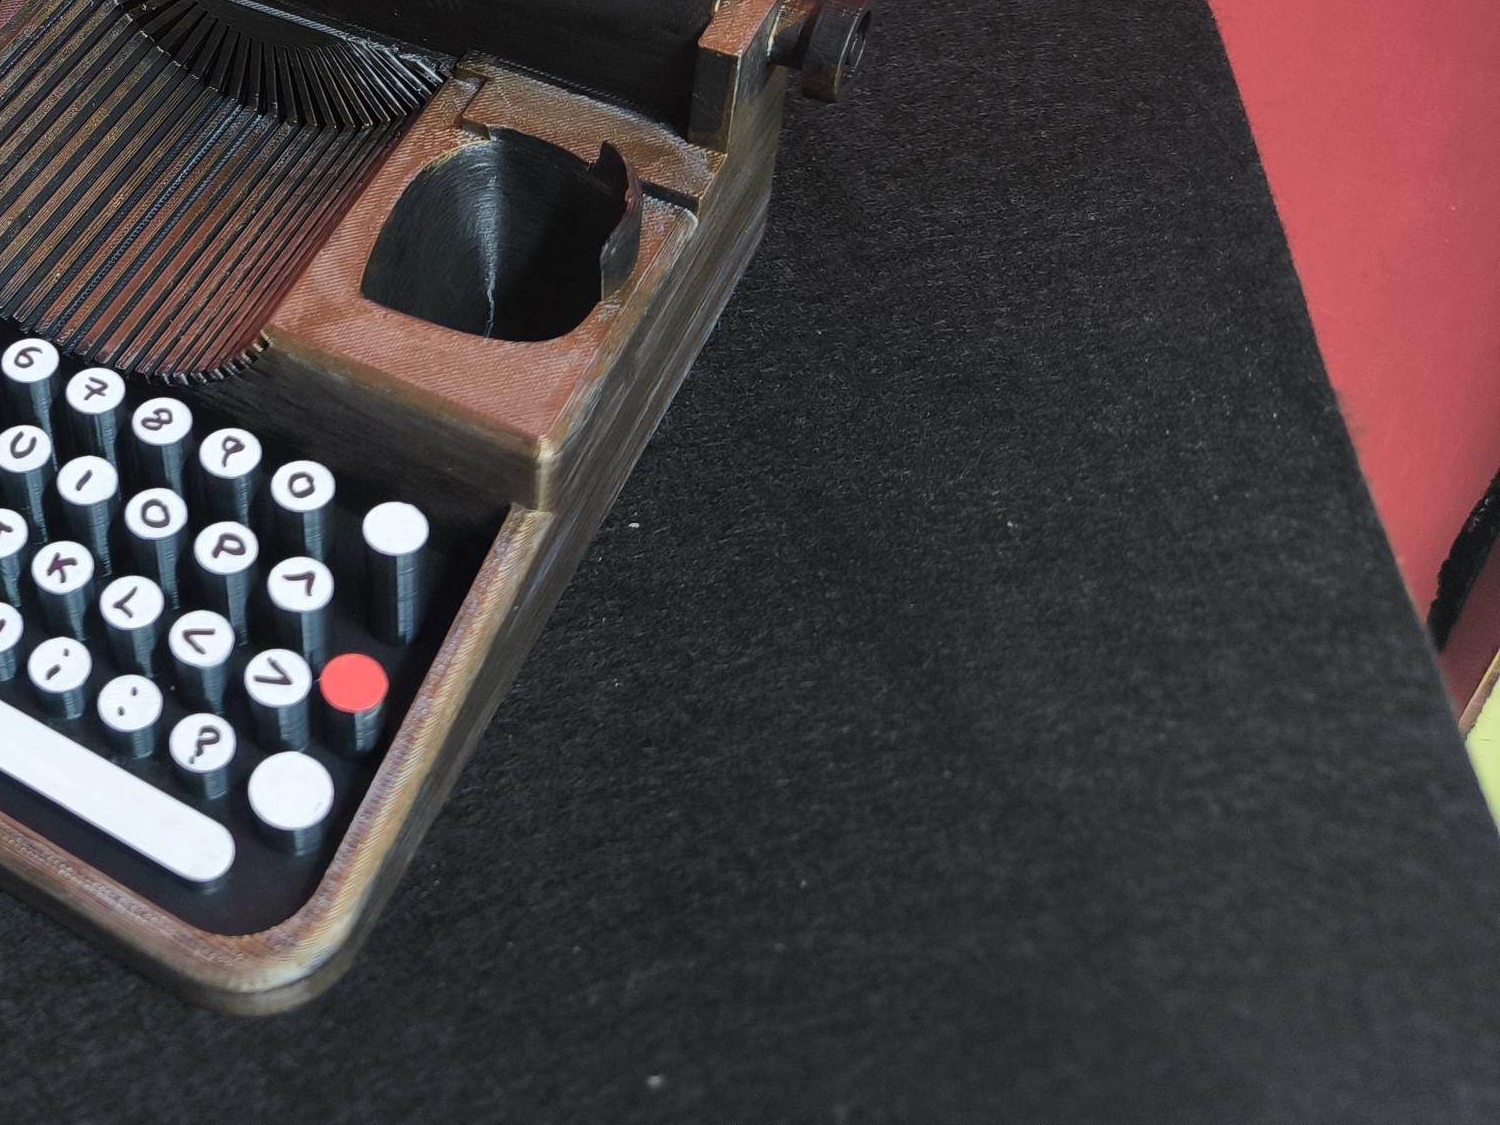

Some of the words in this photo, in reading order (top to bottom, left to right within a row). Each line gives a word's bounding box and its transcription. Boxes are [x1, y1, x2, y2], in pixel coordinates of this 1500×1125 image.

[14, 346, 42, 369] 6
[84, 377, 109, 401] 7
[140, 408, 173, 431] 8
[222, 436, 245, 468] 9
[10, 431, 37, 460] U
[211, 533, 246, 559] P
[46, 552, 78, 584] K
[113, 587, 137, 619] L
[188, 725, 222, 765] ?
